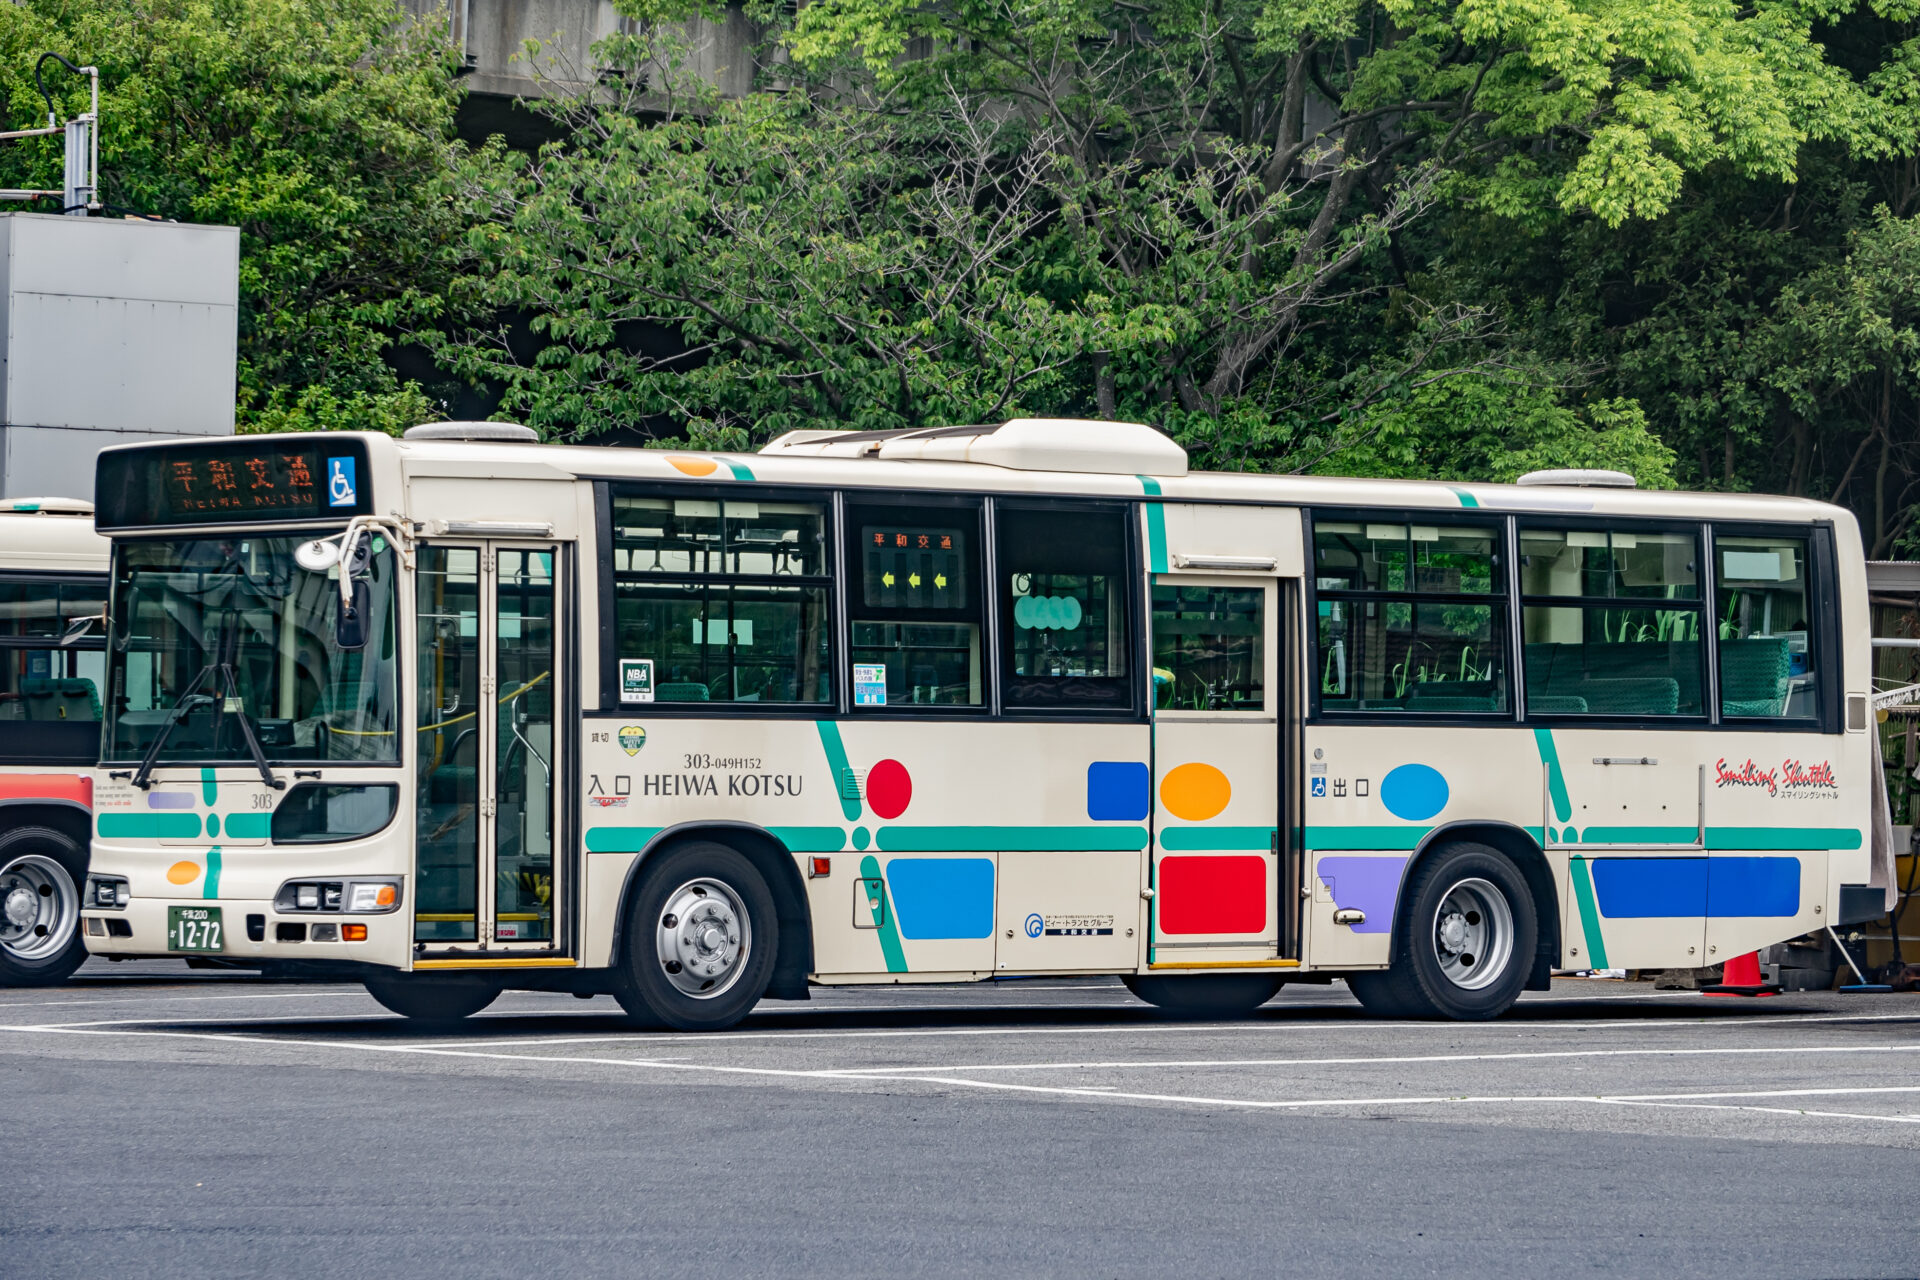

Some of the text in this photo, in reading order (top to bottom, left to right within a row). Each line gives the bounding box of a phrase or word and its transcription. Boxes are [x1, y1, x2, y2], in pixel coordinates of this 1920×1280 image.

[172, 455, 313, 493] 平和交通
[873, 533, 952, 549] 平和交通
[627, 669, 647, 680] NBA
[591, 732, 609, 743] 貸切
[684, 753, 762, 770] 303-049H152
[588, 774, 631, 796] 入口
[644, 774, 803, 797] HEIWA KOTSU
[1715, 758, 1839, 797] Smiling Shuttle
[1333, 778, 1369, 797] 出口
[1780, 791, 1839, 800] スマイリングシャトル
[251, 793, 273, 809] 303
[179, 920, 221, 949] 12-72
